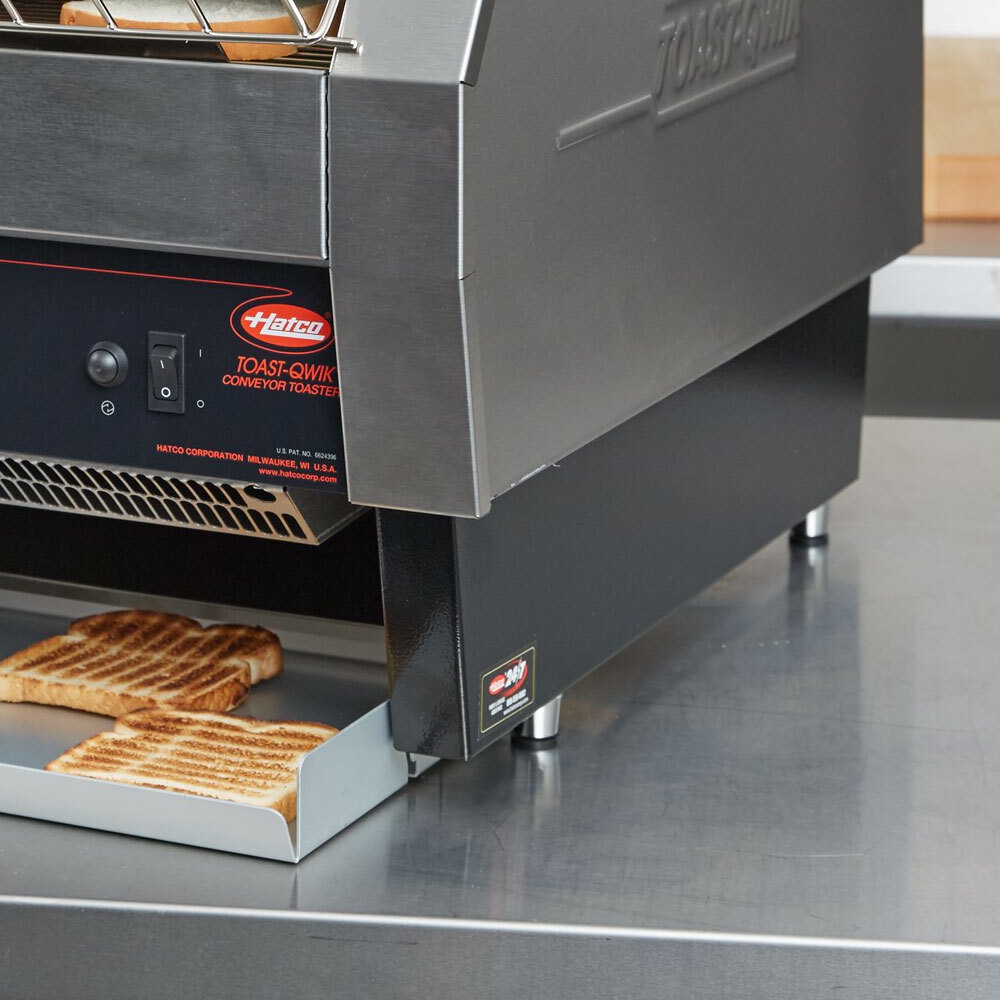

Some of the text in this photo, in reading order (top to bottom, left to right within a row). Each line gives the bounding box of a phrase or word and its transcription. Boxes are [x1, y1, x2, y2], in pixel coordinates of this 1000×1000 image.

[244, 311, 325, 341] Hatco
[222, 374, 286, 391] CONVEYOR
[237, 356, 336, 383] TOAST-QWIK
[156, 444, 337, 473] HATCO CORPORATION MILWAUKEE, WI U.S.A.
[258, 468, 337, 483] www.hatcocorp.com
